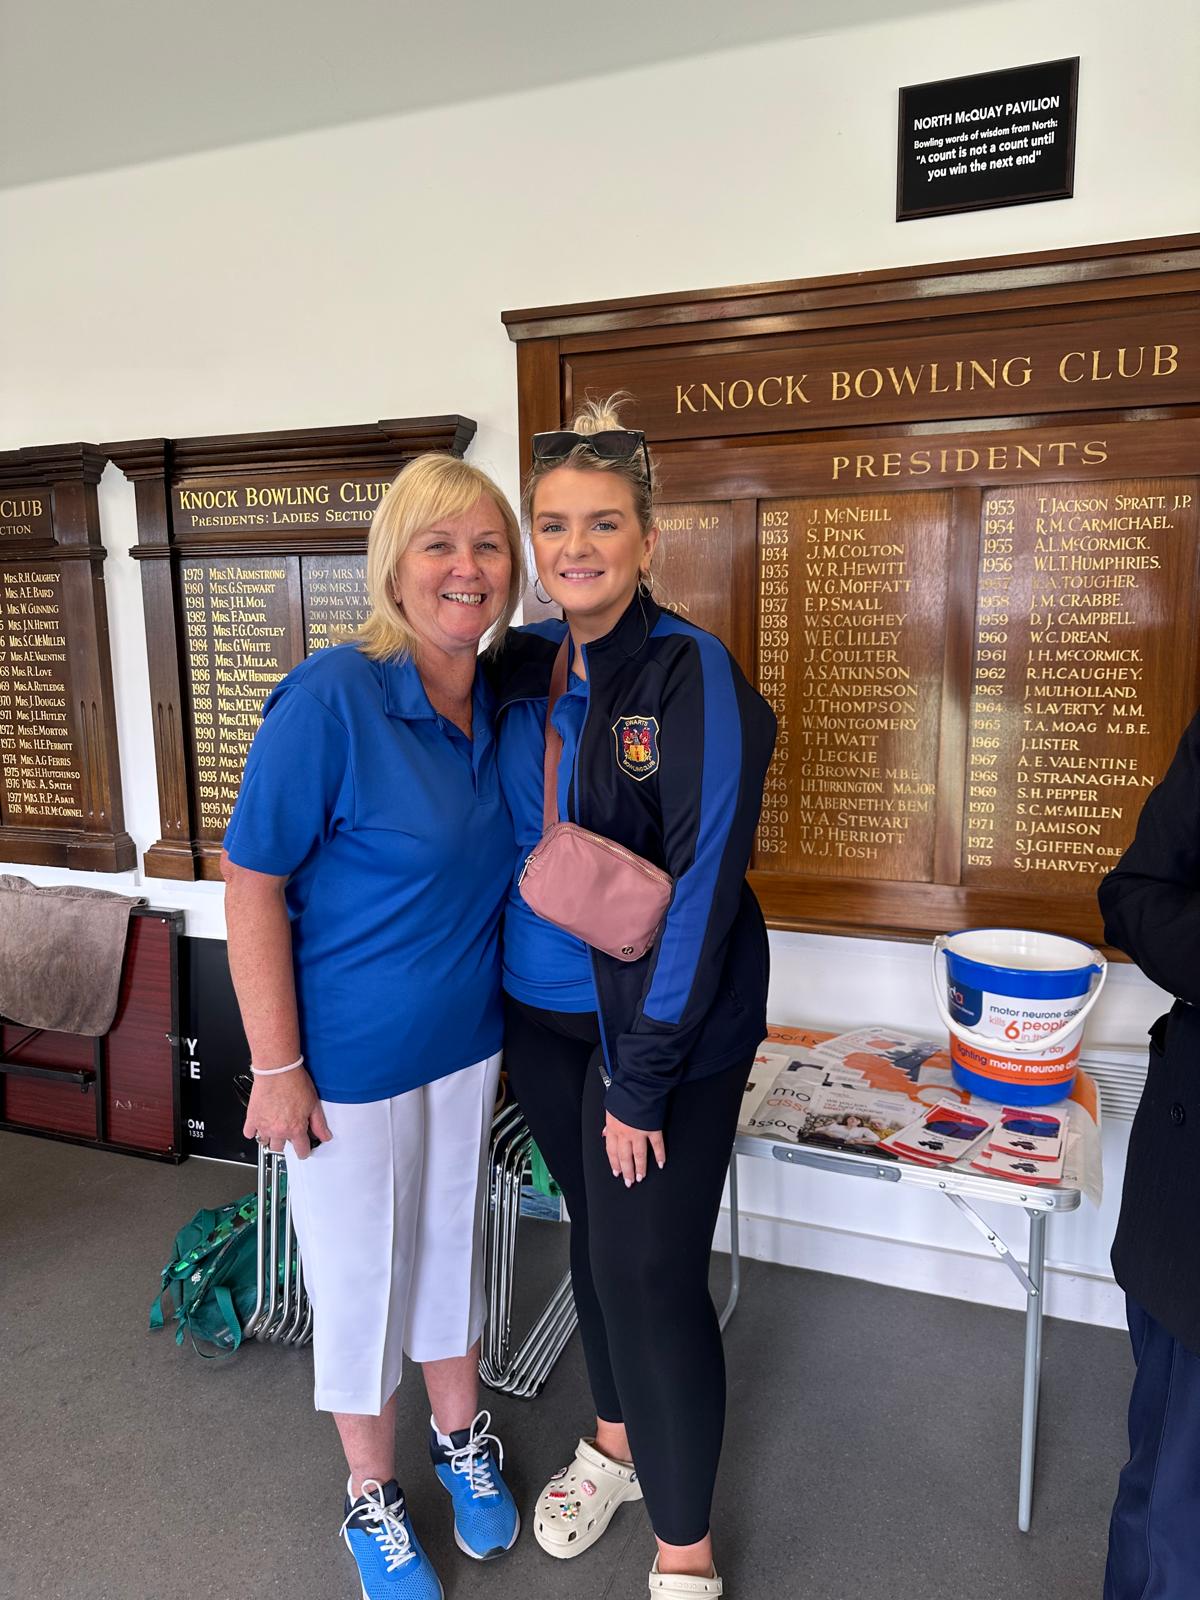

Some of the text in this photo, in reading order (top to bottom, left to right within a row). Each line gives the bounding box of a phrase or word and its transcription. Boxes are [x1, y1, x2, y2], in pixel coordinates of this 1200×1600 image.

[914, 96, 1060, 131] NORTH McQUAY PAVILION
[914, 119, 1058, 149] Bowling words of wisdom from North:
[917, 132, 1054, 164] "A count is not a count until
[928, 151, 1041, 182] you win the next end"
[675, 345, 1179, 414] KNOCK BOWLING CLUB
[831, 440, 1109, 480] PRESIDENTS
[179, 490, 238, 510] KNOCK
[245, 485, 330, 507] BOWLING
[1, 500, 42, 518] CLUB
[986, 500, 1015, 516] 1953
[1050, 498, 1108, 516] JACKSON
[1172, 495, 1192, 511] J.P.
[192, 509, 377, 527] PRESIDENTS: LADIES SECTIO
[655, 517, 692, 531] ORDIE
[763, 512, 789, 526] 1932
[808, 509, 820, 524] J.
[985, 519, 1015, 534] 1954
[762, 528, 866, 544] 1933 S. PINK
[984, 539, 1013, 554] 1955
[762, 548, 788, 561] 1934
[983, 557, 1012, 572] 1956
[184, 568, 204, 581] 1979
[309, 570, 329, 579] 1997
[762, 565, 789, 578] 1935
[185, 583, 203, 595] 1980
[310, 583, 352, 592] 1998 MRS
[761, 581, 789, 595] 1936
[186, 597, 204, 609] 1981
[310, 597, 328, 606] 1999
[761, 598, 788, 612] 1937
[980, 595, 1009, 607] 1958
[187, 611, 206, 623] 1982
[310, 611, 327, 620] 2000
[761, 615, 788, 629] 1938
[979, 613, 1008, 626] 1959
[188, 625, 207, 636] 1983
[309, 624, 327, 634] 2001
[309, 638, 329, 648] 2002
[760, 631, 789, 647] 1939
[978, 632, 1007, 643] 1960
[190, 639, 208, 651] 1984
[190, 654, 209, 667] 1985
[760, 650, 788, 663] 1940
[821, 649, 900, 663] COULTER
[977, 650, 1006, 662] 1961
[191, 669, 210, 681] 1986
[760, 665, 785, 680] 1941
[976, 668, 1006, 679] 1962
[192, 684, 210, 695] 1987
[759, 683, 787, 697] 1942
[975, 685, 1003, 696] 1963
[194, 698, 212, 710] 1988
[975, 703, 1002, 714] 1964
[1113, 704, 1145, 717] M.M.
[194, 713, 213, 725] 1989
[974, 719, 1150, 735] 1965 MOAG M.B.E.
[195, 728, 215, 740] 1990
[196, 742, 214, 754] 1991
[972, 737, 1000, 748] 1966
[2, 754, 16, 764] 1974
[198, 756, 215, 767] 1992
[819, 749, 877, 764] LECKIE
[971, 754, 998, 765] 1967
[4, 767, 19, 777] 1975
[199, 771, 217, 782] 1993
[6, 779, 20, 788] 1976
[49, 780, 72, 790] SMITH
[970, 771, 1154, 787] 1968 STRANAGHAN
[200, 786, 219, 799] 1994
[893, 783, 936, 795] MAJOR
[970, 786, 997, 797] 1969
[8, 792, 21, 802] 1977
[762, 793, 788, 807] 949
[8, 804, 22, 813] 1978
[201, 802, 220, 814] 1995
[969, 802, 995, 813] 1970
[202, 817, 222, 828] 1996
[968, 818, 1101, 837] 1971 JAMISON
[758, 825, 783, 838] 1951
[758, 839, 787, 853] 1952
[968, 836, 994, 849] 1972
[968, 854, 992, 866] 1973
[990, 1005, 1020, 1016] motor
[1022, 1011, 1061, 1019] neurone
[989, 1015, 1006, 1027] kills
[1005, 1020, 1020, 1040] 6
[990, 1059, 1022, 1072] motor
[1025, 1064, 1065, 1073] neurone
